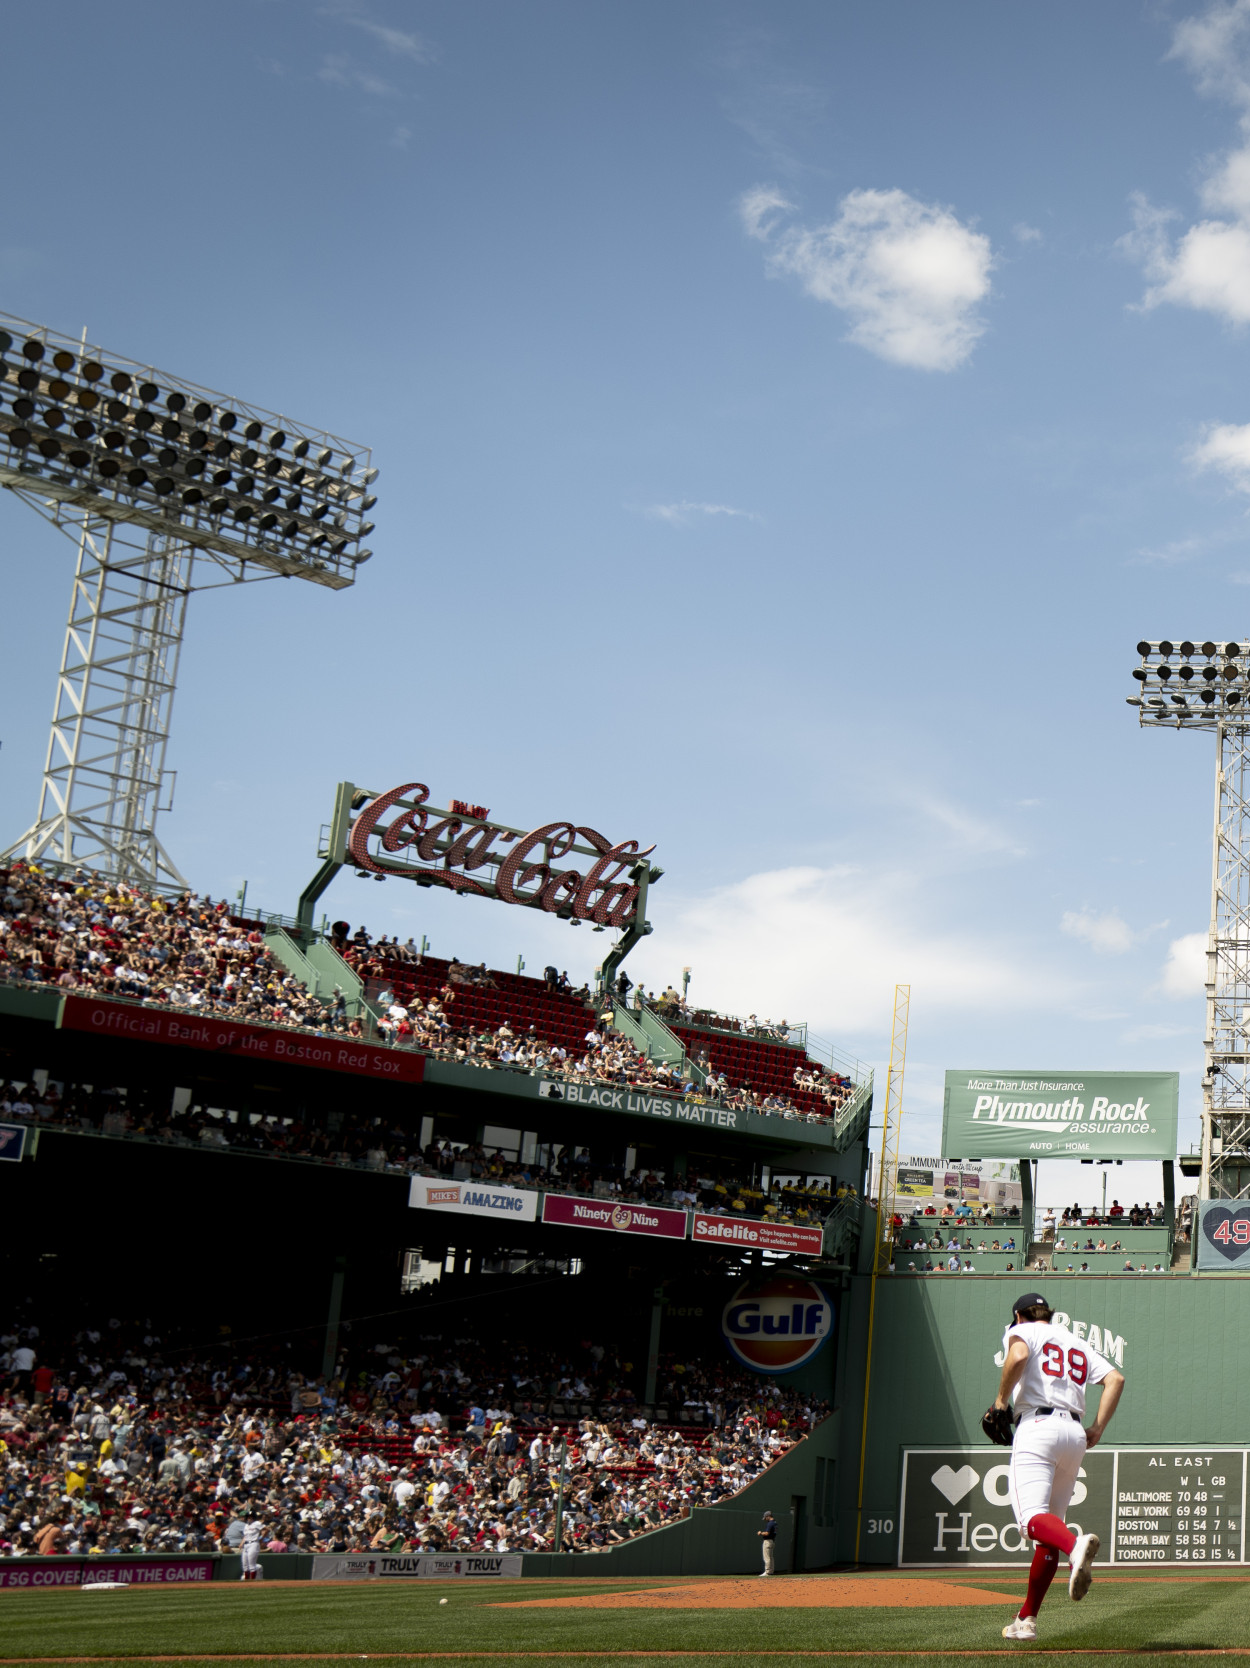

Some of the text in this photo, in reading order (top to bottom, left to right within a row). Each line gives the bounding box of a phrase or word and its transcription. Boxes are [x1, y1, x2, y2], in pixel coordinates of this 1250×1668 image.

[449, 799, 491, 822] ENJOY
[350, 783, 657, 927] Coca-Cola
[91, 1010, 400, 1073] Official Bank of the Boston Red Sox
[967, 1079, 1086, 1091] More Than Just Insurance.
[567, 1085, 737, 1128] BLACK LIVES MATTER
[972, 1095, 1151, 1122] Plymouth Rock
[1069, 1122, 1150, 1134] assurance
[1029, 1142, 1053, 1150] AUTO
[1065, 1142, 1090, 1150] HOME
[910, 1156, 951, 1169] IMMUNITY
[431, 1191, 458, 1201] MIKE'S
[463, 1191, 524, 1211] AMAZING
[573, 1205, 612, 1222] Ninety
[632, 1212, 659, 1227] Nine
[696, 1221, 759, 1241] Safelite
[726, 1303, 824, 1335] Gulf
[1042, 1342, 1088, 1386] 39
[1148, 1457, 1213, 1467] AL EAST
[1211, 1476, 1226, 1486] GB
[1118, 1492, 1208, 1502] BALTIMORE 70 48
[1118, 1506, 1208, 1516] NEW YORK 69 49
[867, 1519, 894, 1534] 310
[1118, 1520, 1207, 1531] BOSTON 61 54
[1117, 1534, 1221, 1545] TAMPA BAY 58 58 11
[1117, 1549, 1222, 1560] TORONTO 54 63 15
[381, 1558, 420, 1571] TRULY
[466, 1558, 503, 1571] TRULY
[8, 1567, 207, 1586] 5G COVERAGE IN THE GAME
